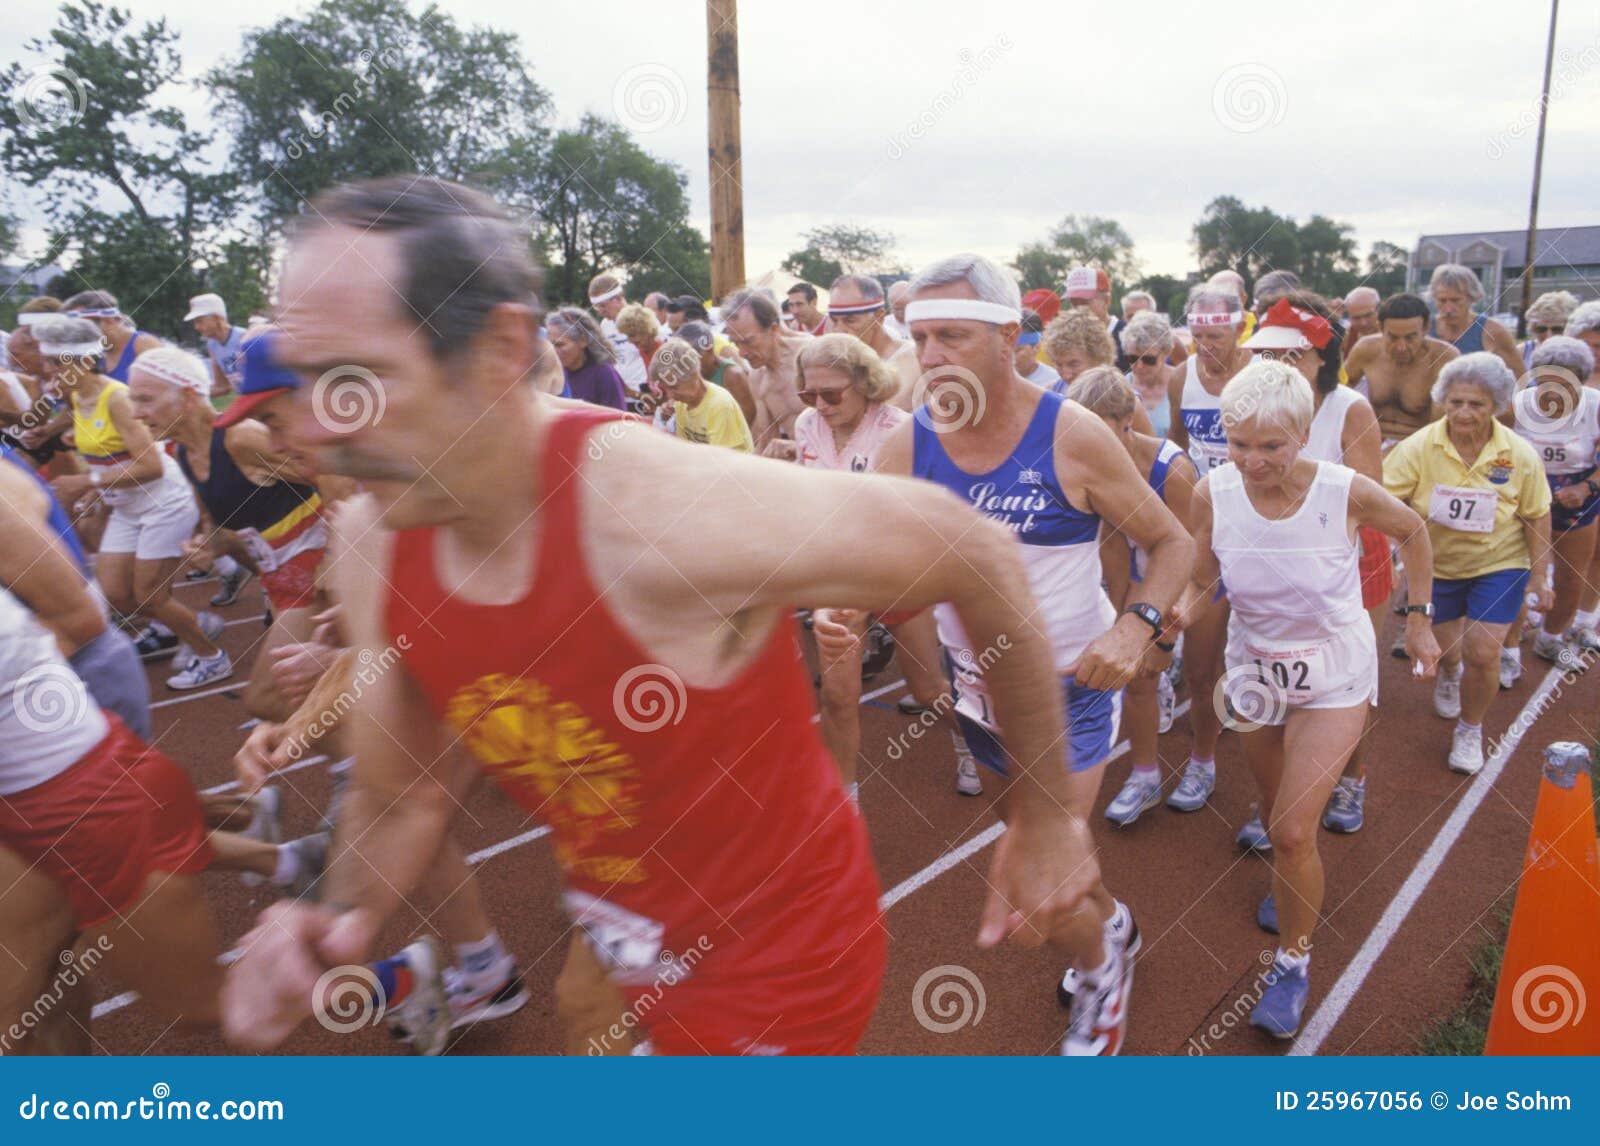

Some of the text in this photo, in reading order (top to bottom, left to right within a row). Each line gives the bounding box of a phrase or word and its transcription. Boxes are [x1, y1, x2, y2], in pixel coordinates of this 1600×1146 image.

[1543, 447, 1566, 462] 95
[968, 482, 1046, 511] Louis
[1448, 498, 1477, 521] 97
[1253, 659, 1311, 690] 102
